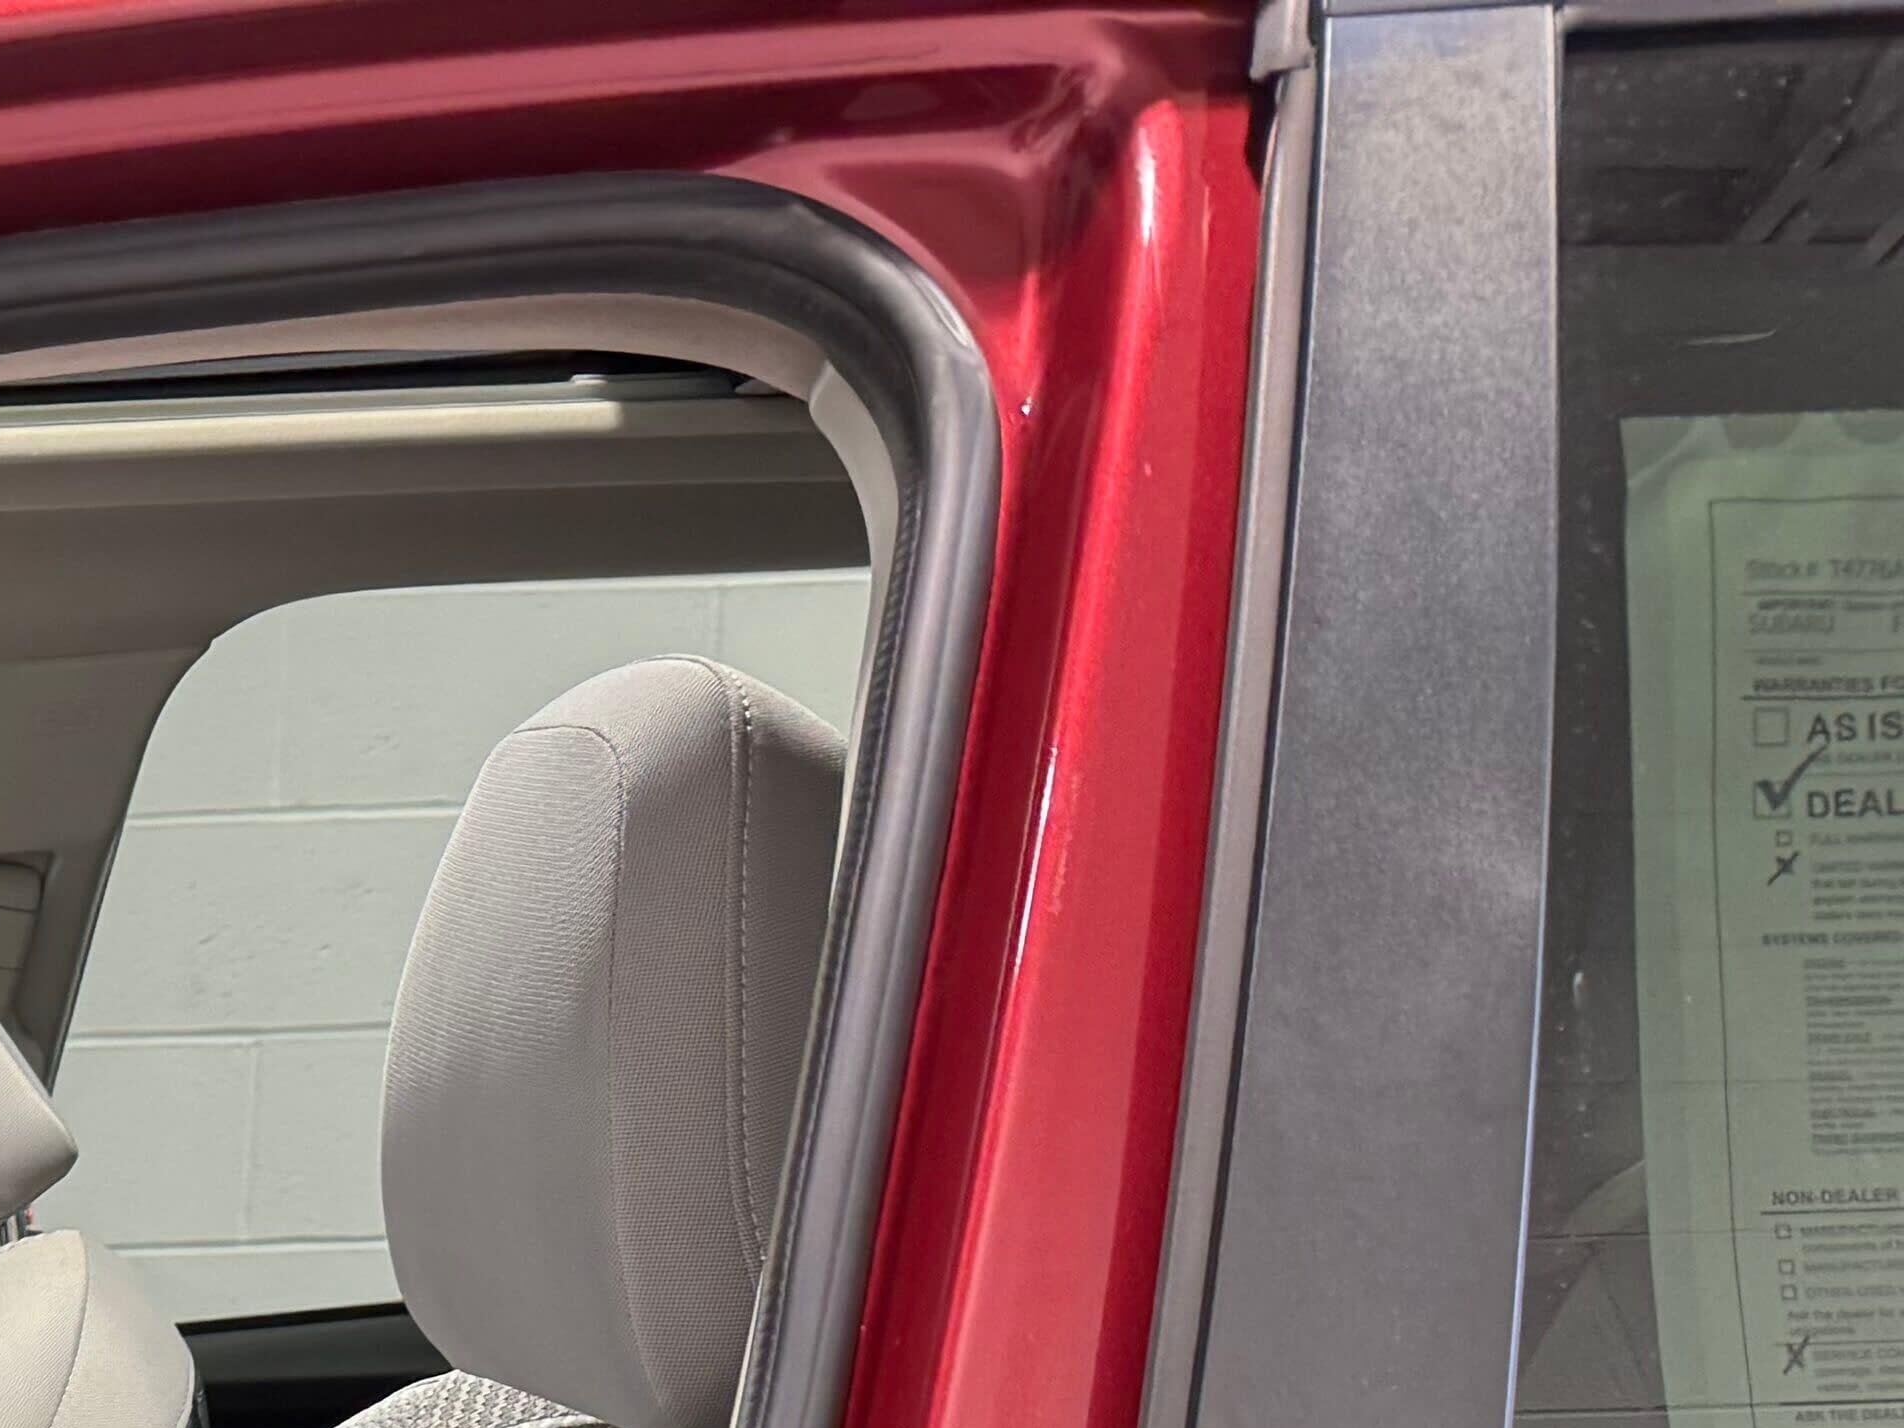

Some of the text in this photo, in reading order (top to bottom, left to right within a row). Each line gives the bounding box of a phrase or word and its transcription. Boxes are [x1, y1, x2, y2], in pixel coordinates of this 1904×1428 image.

[1806, 709, 1904, 744] AS IS
[1806, 786, 1904, 819] DEAL
